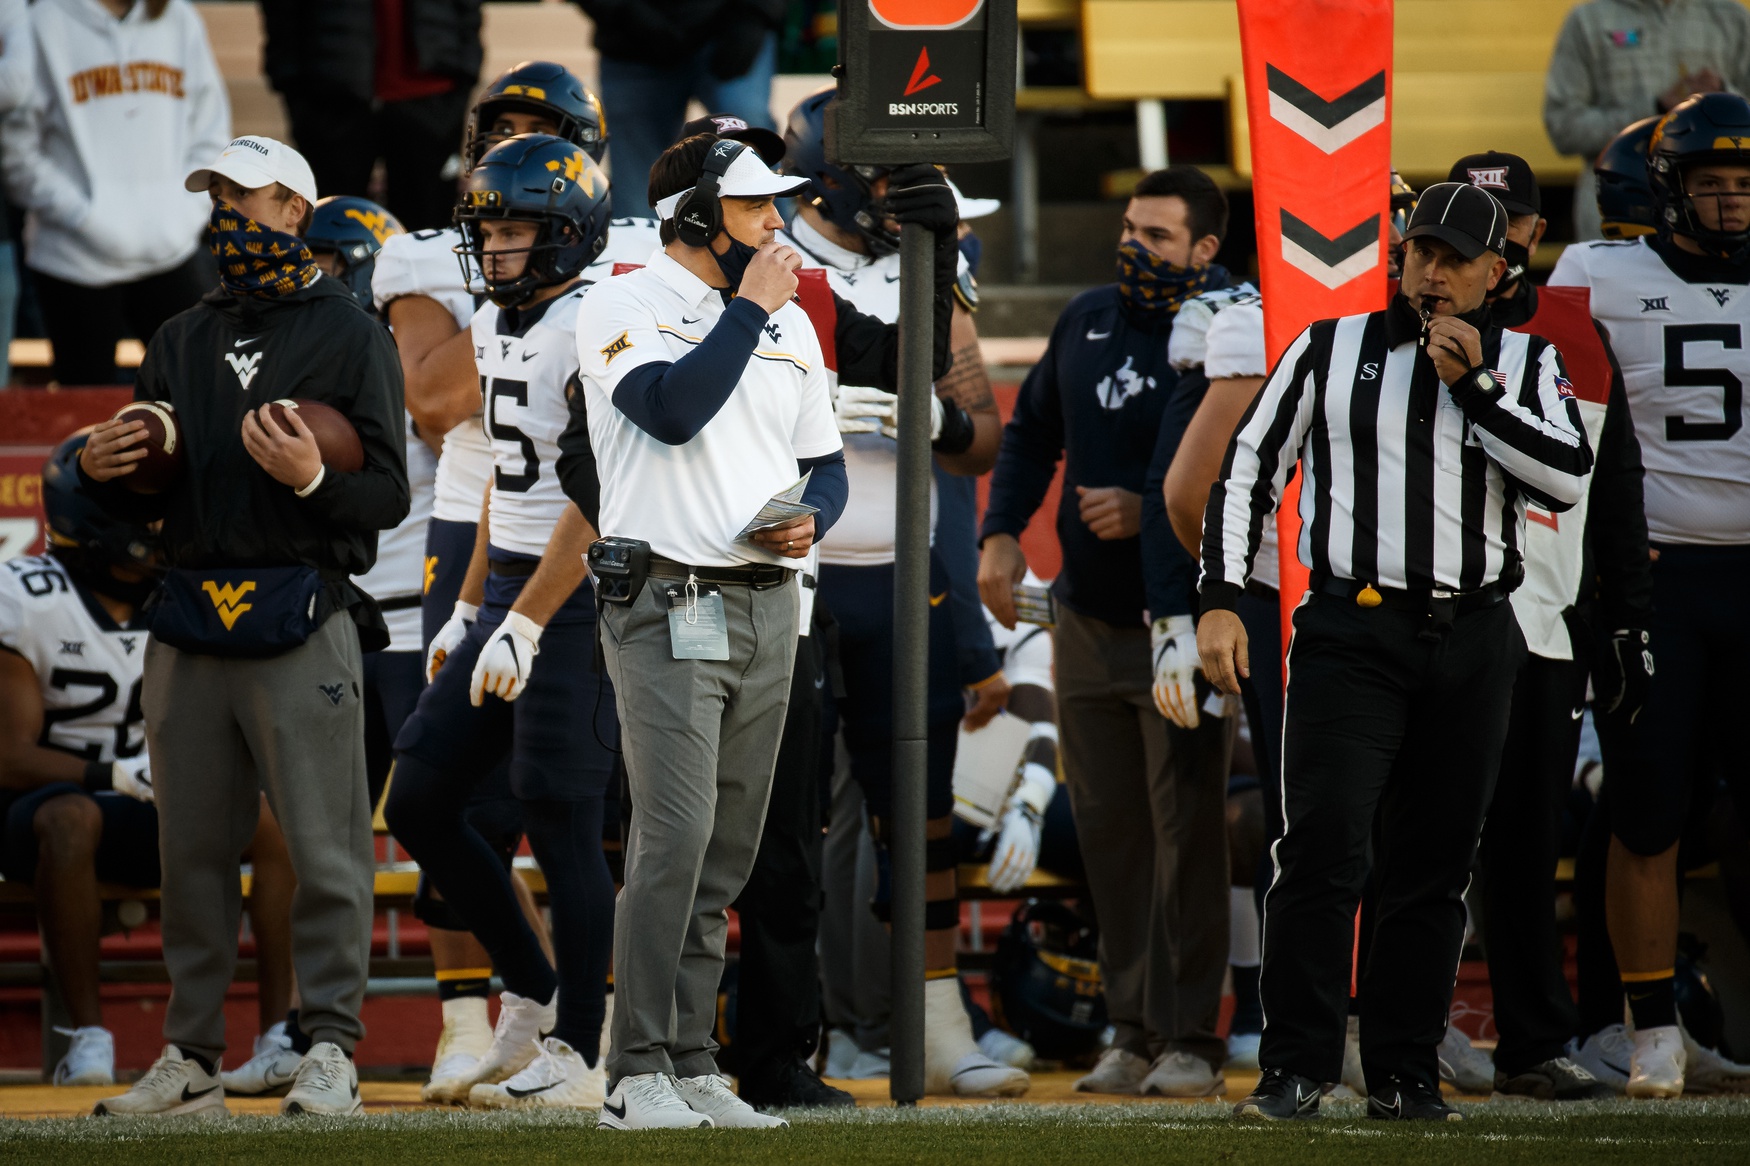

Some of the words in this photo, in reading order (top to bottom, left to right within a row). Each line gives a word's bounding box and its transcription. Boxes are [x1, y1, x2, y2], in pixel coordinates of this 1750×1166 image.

[124, 61, 185, 100] STATE
[1640, 297, 1670, 313] XII
[1664, 323, 1743, 441] 5
[480, 374, 540, 493] 5
